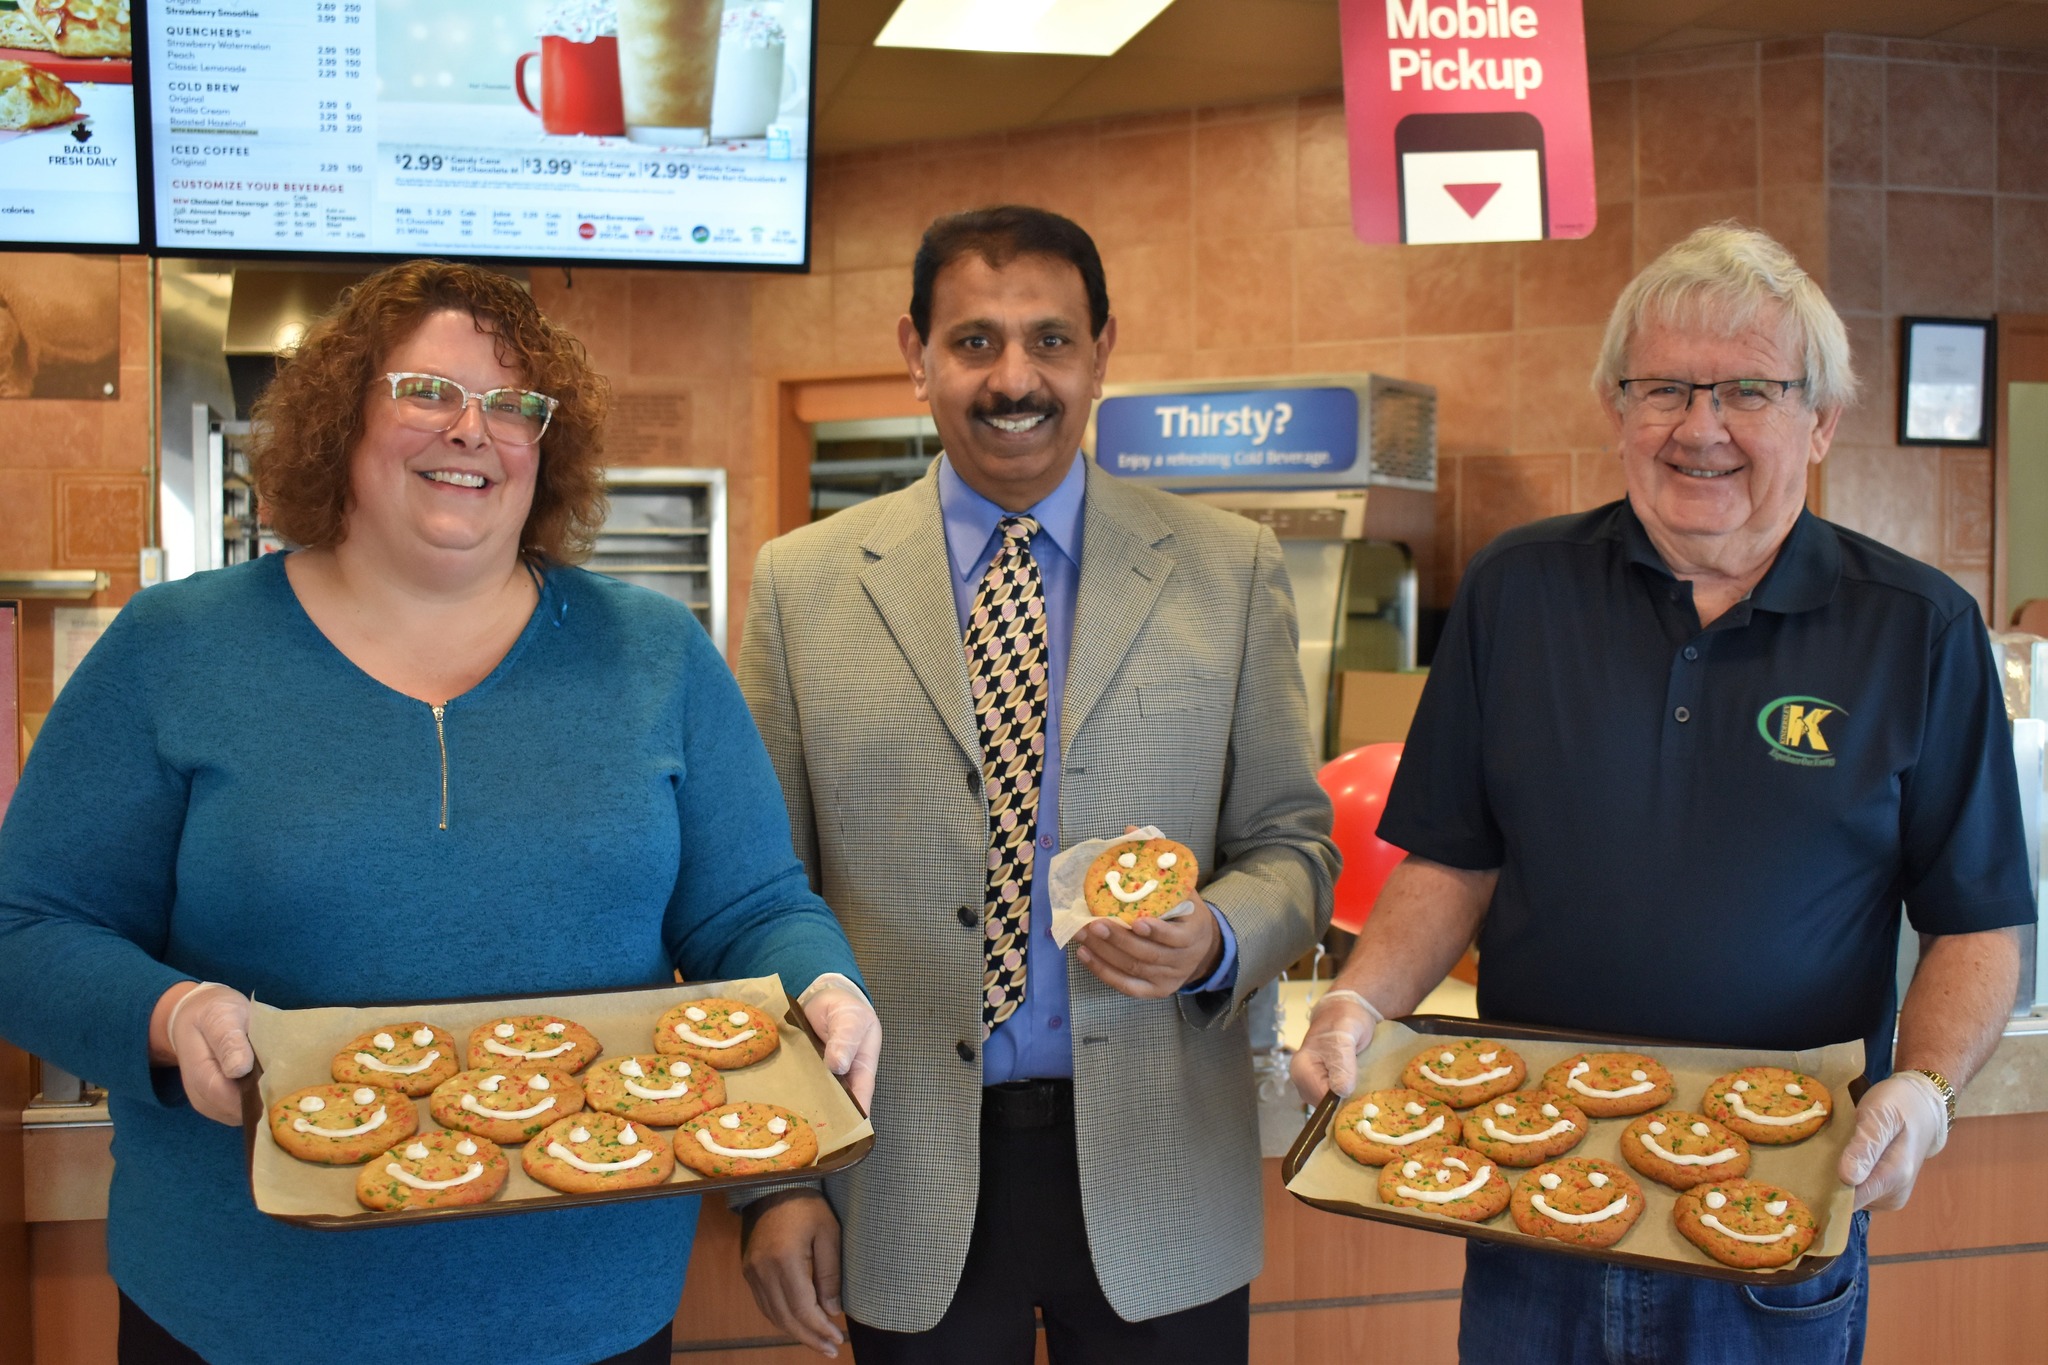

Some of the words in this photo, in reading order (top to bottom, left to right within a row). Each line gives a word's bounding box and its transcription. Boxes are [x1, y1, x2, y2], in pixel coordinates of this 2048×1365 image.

[166, 7, 216, 18] Strawberry
[218, 8, 259, 18] Smoothie
[1385, 0, 1539, 39] Mobile
[167, 39, 216, 50] Strawberry
[217, 41, 271, 51] Watermelon
[167, 50, 195, 60] Peach
[167, 62, 199, 71] Classic
[200, 63, 247, 73] Lemonade
[1388, 48, 1543, 100] Pickup
[168, 82, 202, 92] COLD
[206, 83, 240, 93] BREW
[169, 94, 205, 105] Original
[169, 106, 199, 115] Vanilla
[200, 106, 231, 115] Cream
[170, 117, 206, 127] Roasted
[207, 118, 247, 128] Hazelnut
[64, 145, 102, 155] BAKED
[171, 145, 200, 155] ICED
[203, 146, 250, 156] COFFEE
[48, 156, 83, 166] FRESH
[86, 157, 118, 167] DAILY
[171, 157, 207, 168] Original
[395, 154, 443, 171] $2.99
[526, 157, 572, 175] $3.99
[644, 162, 690, 180] $2.99
[172, 180, 243, 191] CUSTOMIZE
[246, 182, 279, 192] YOUR
[284, 183, 344, 193] BEVERAGE
[1, 205, 35, 215] calories
[1155, 402, 1293, 446] Thirsty?
[1118, 453, 1150, 470] Enjoy
[1154, 455, 1163, 467] a
[1166, 452, 1231, 469] refreshing
[1234, 450, 1263, 465] Cold
[1266, 451, 1332, 467] Beverage.
